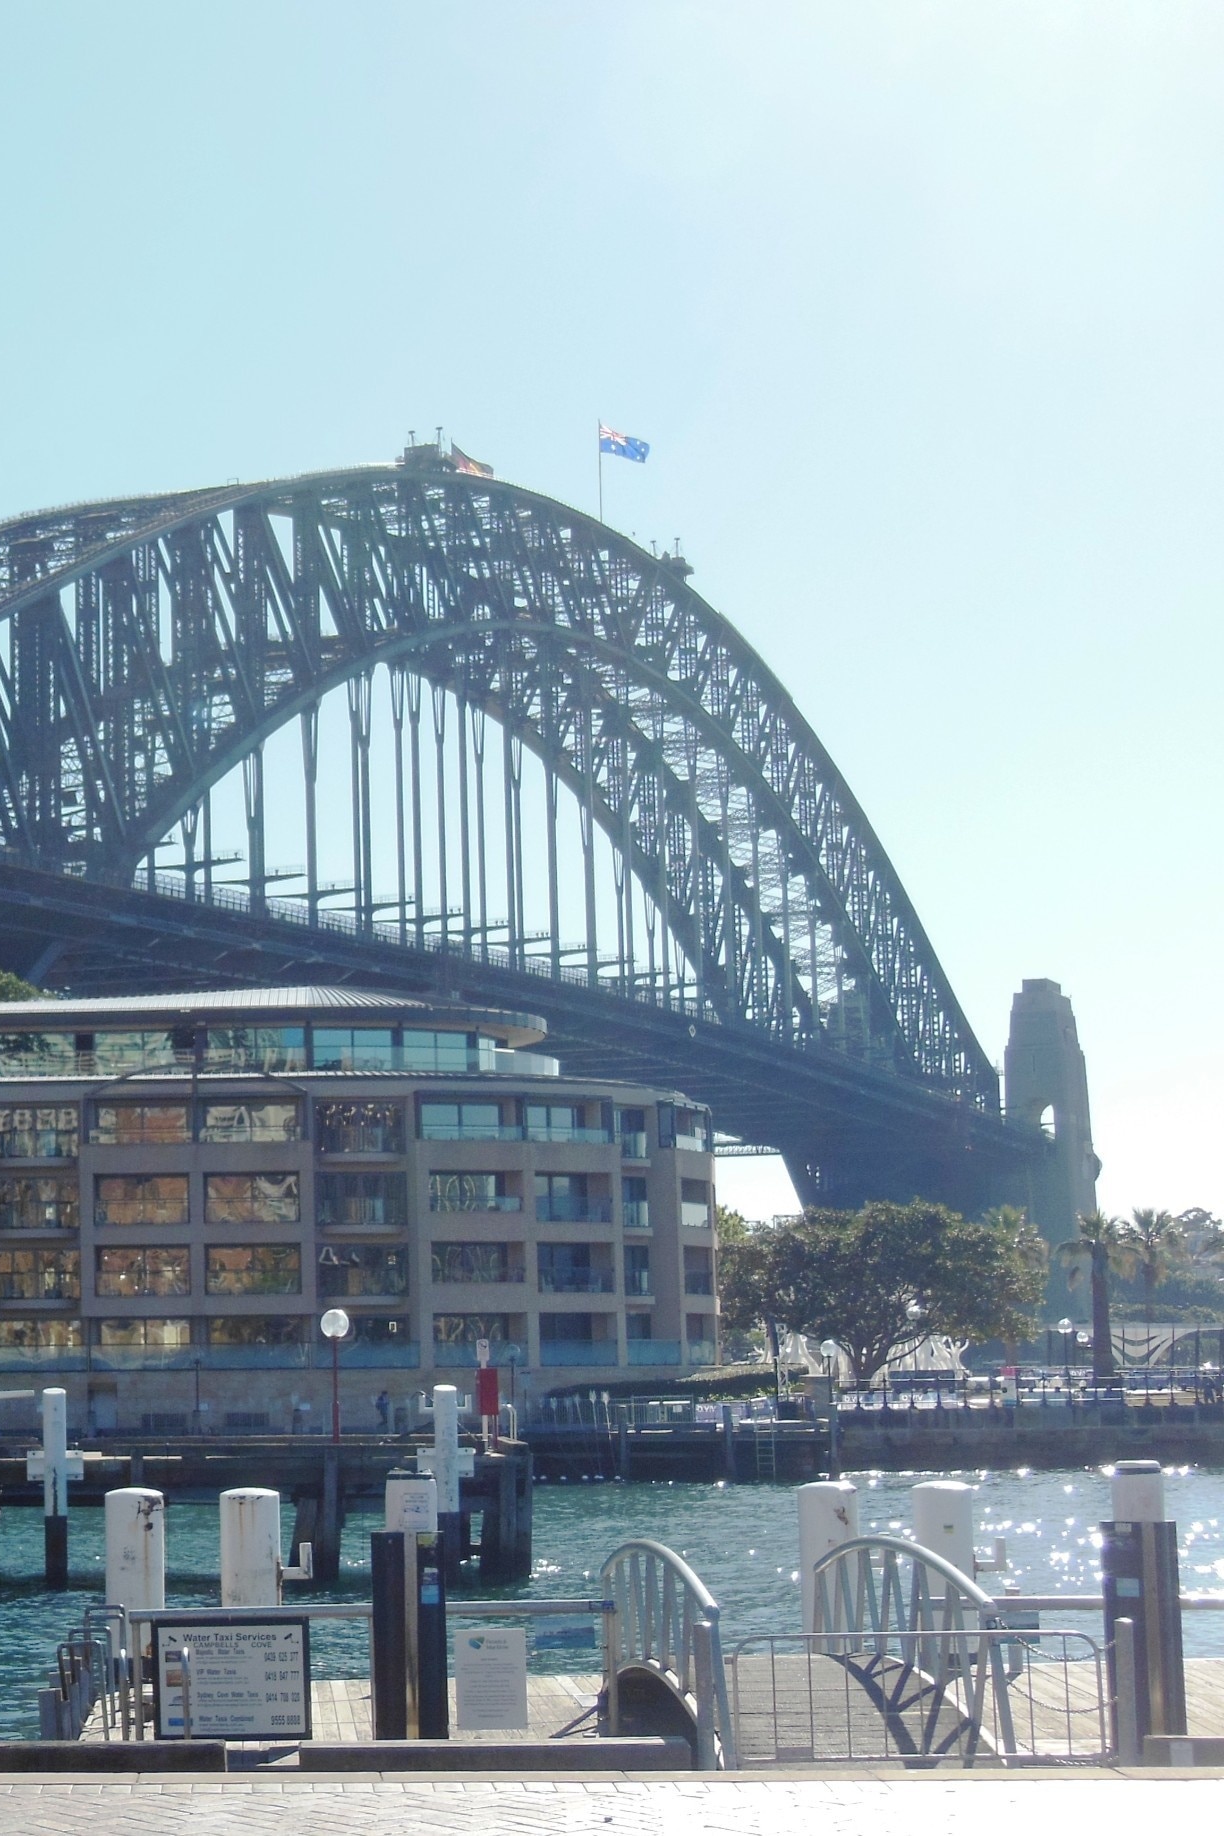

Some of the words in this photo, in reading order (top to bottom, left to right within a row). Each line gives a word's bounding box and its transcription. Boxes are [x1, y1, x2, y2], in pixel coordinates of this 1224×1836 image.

[183, 1634, 211, 1642] Water
[214, 1633, 233, 1641] Taxi
[236, 1633, 277, 1641] Services
